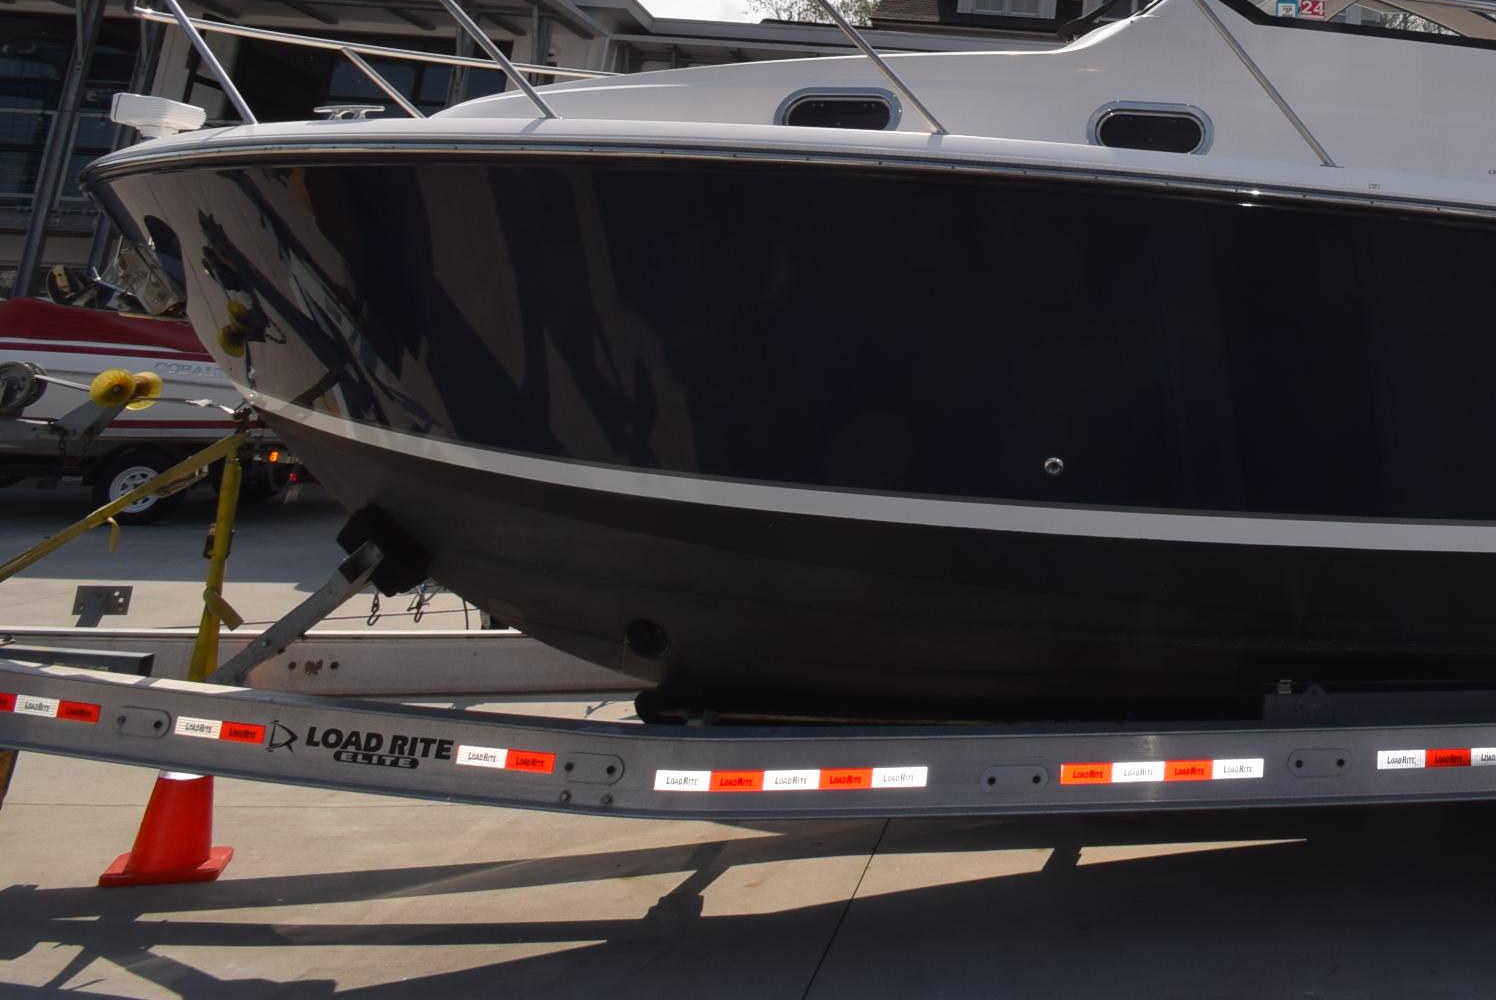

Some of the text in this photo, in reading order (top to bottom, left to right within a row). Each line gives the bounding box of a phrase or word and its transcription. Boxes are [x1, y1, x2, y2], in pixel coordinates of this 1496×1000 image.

[1302, 0, 1325, 16] 24
[306, 727, 454, 760] LOAD RITE
[340, 752, 411, 767] ELITE
